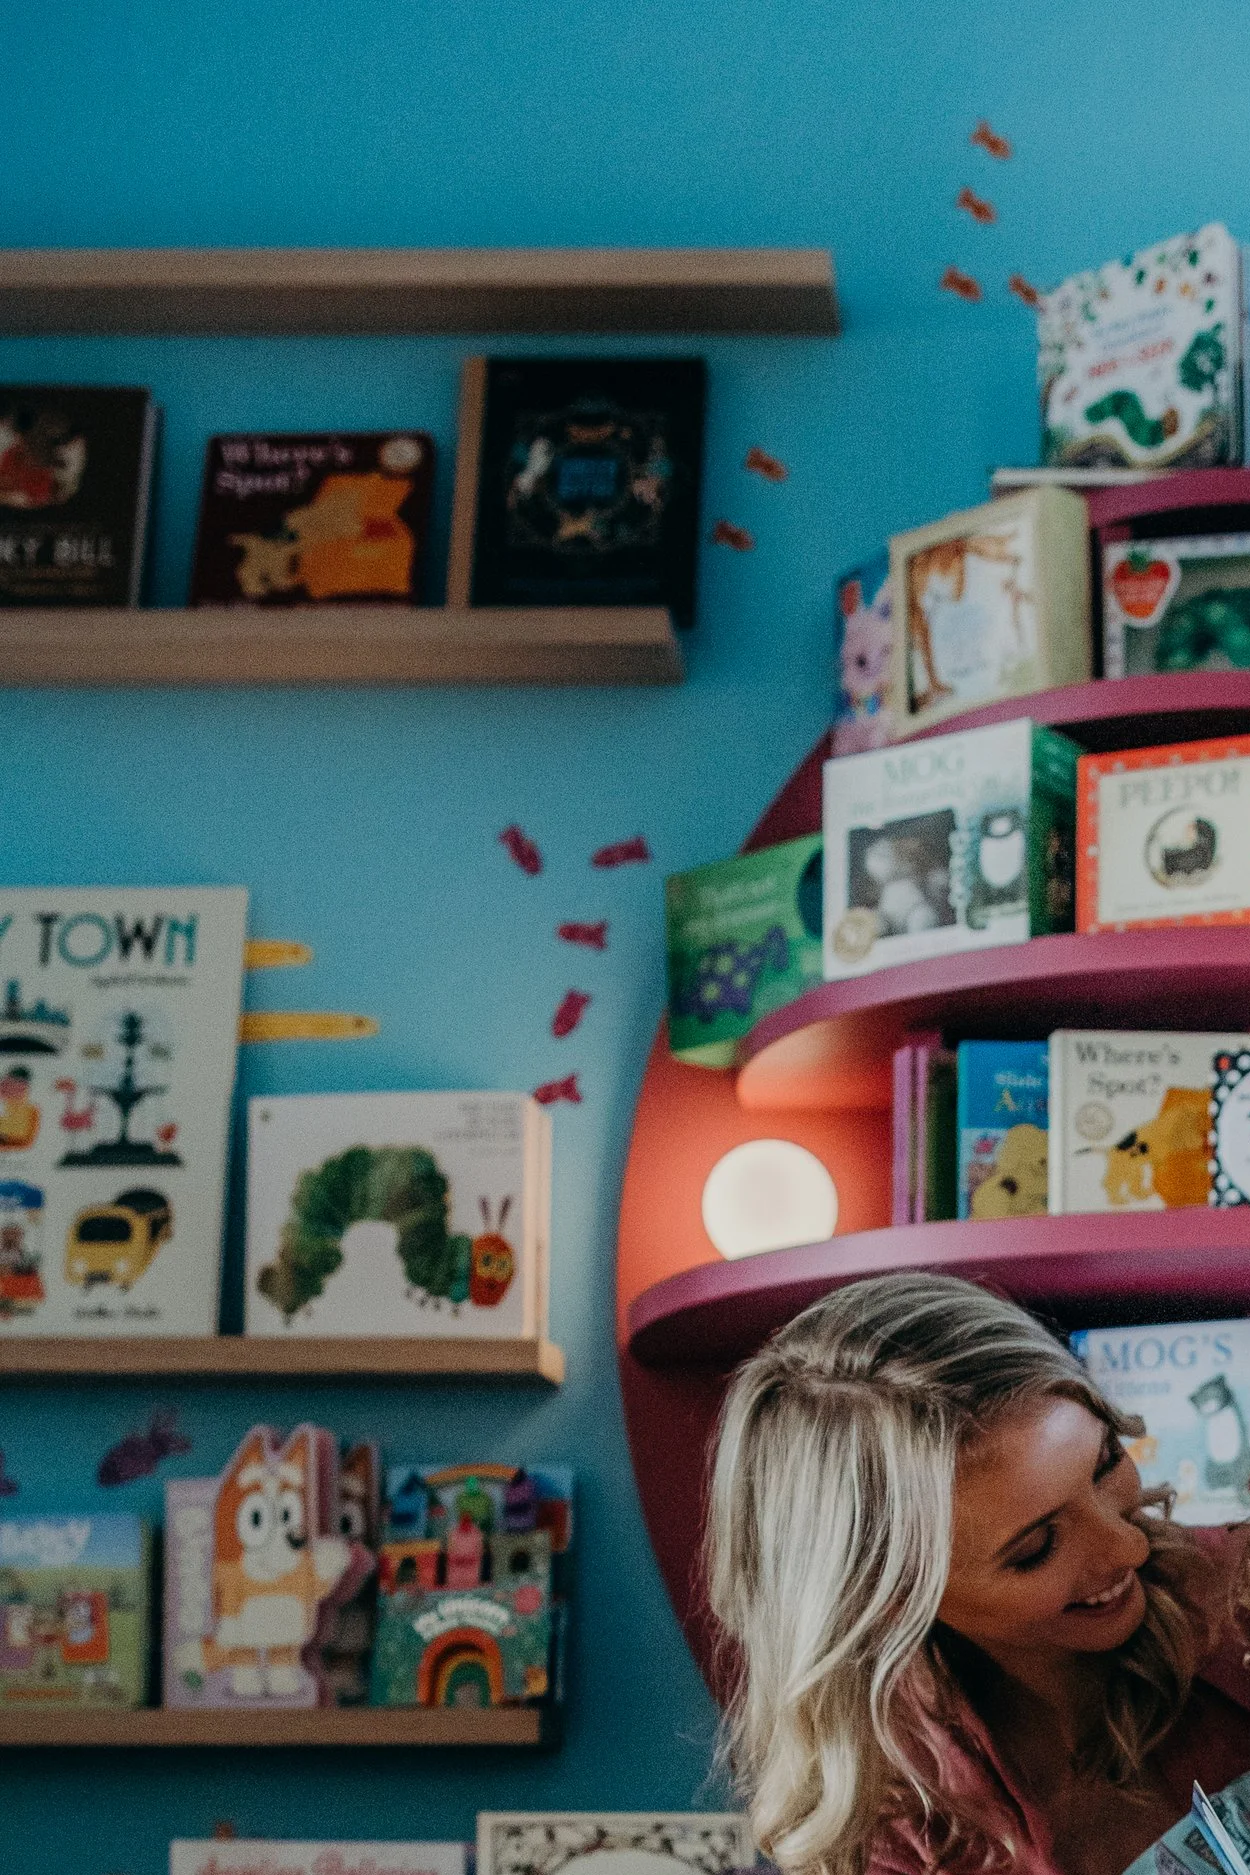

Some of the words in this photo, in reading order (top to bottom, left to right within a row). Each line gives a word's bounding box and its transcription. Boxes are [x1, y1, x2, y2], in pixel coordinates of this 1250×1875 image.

[31, 909, 200, 968] TOWN
[1075, 1041, 1181, 1066] Where's
[1101, 1333, 1233, 1372] MOG'S
